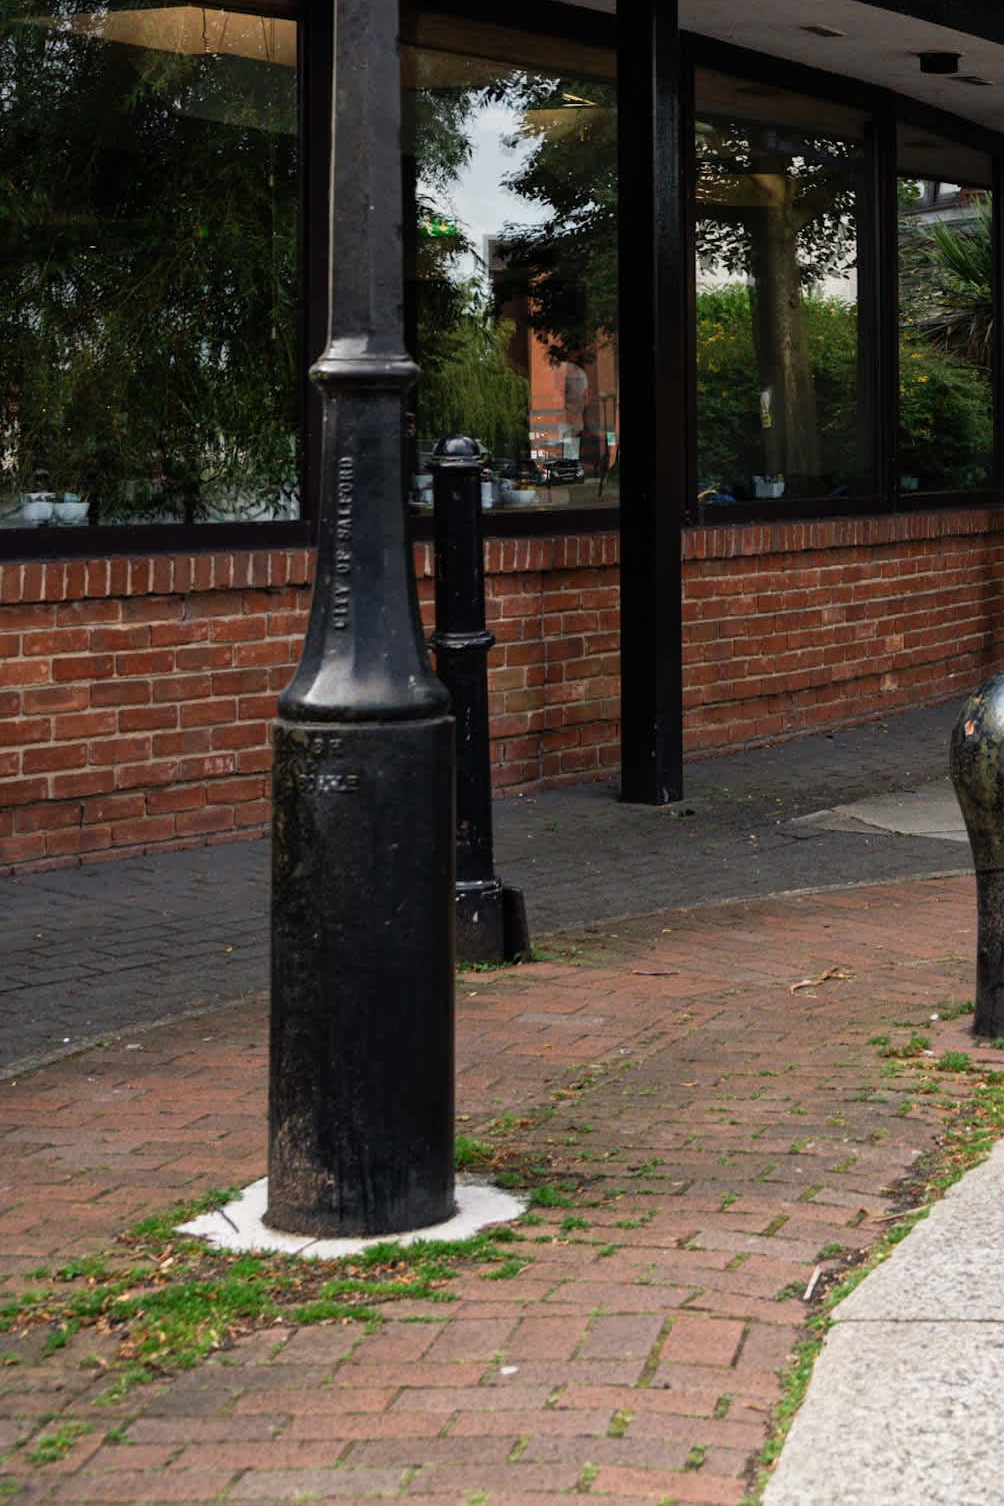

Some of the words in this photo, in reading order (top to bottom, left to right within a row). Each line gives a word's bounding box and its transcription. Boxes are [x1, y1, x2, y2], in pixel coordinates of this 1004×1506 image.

[336, 456, 353, 540] SALFORD
[335, 549, 352, 574] OF
[333, 584, 349, 630] CITY
